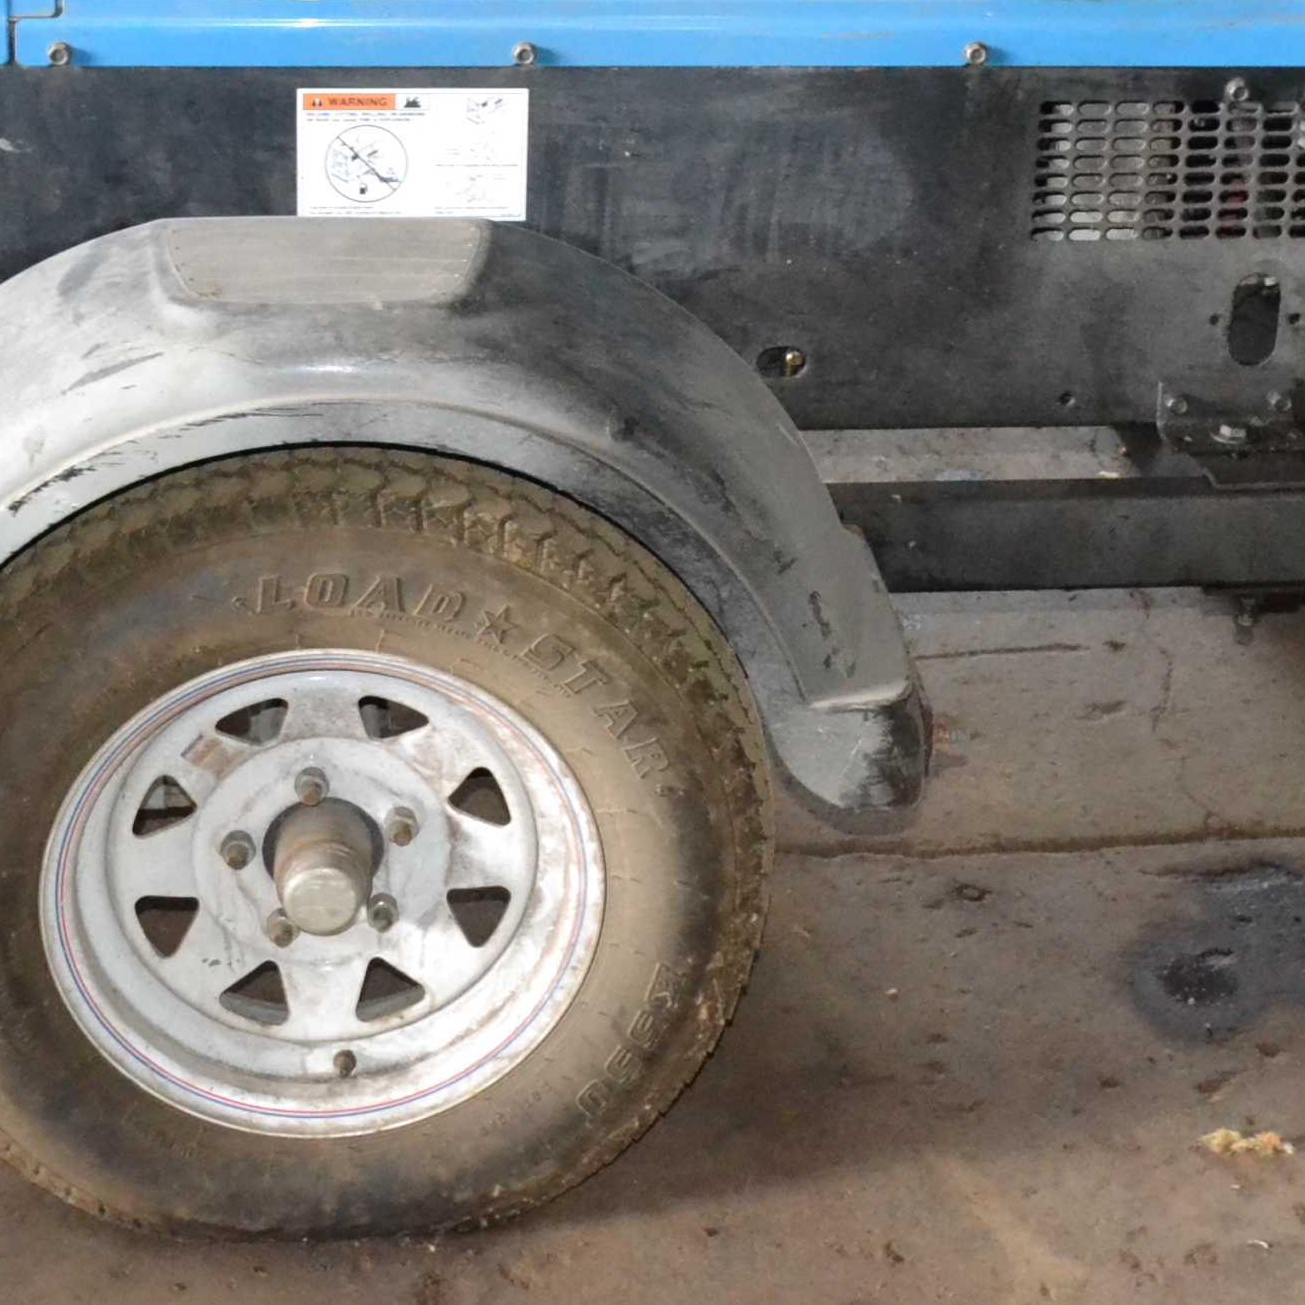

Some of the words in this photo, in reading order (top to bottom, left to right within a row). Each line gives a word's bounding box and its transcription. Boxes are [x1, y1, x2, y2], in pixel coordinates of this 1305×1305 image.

[328, 97, 388, 107] WARNING
[254, 571, 466, 622] LOAD
[522, 632, 671, 781] STAR
